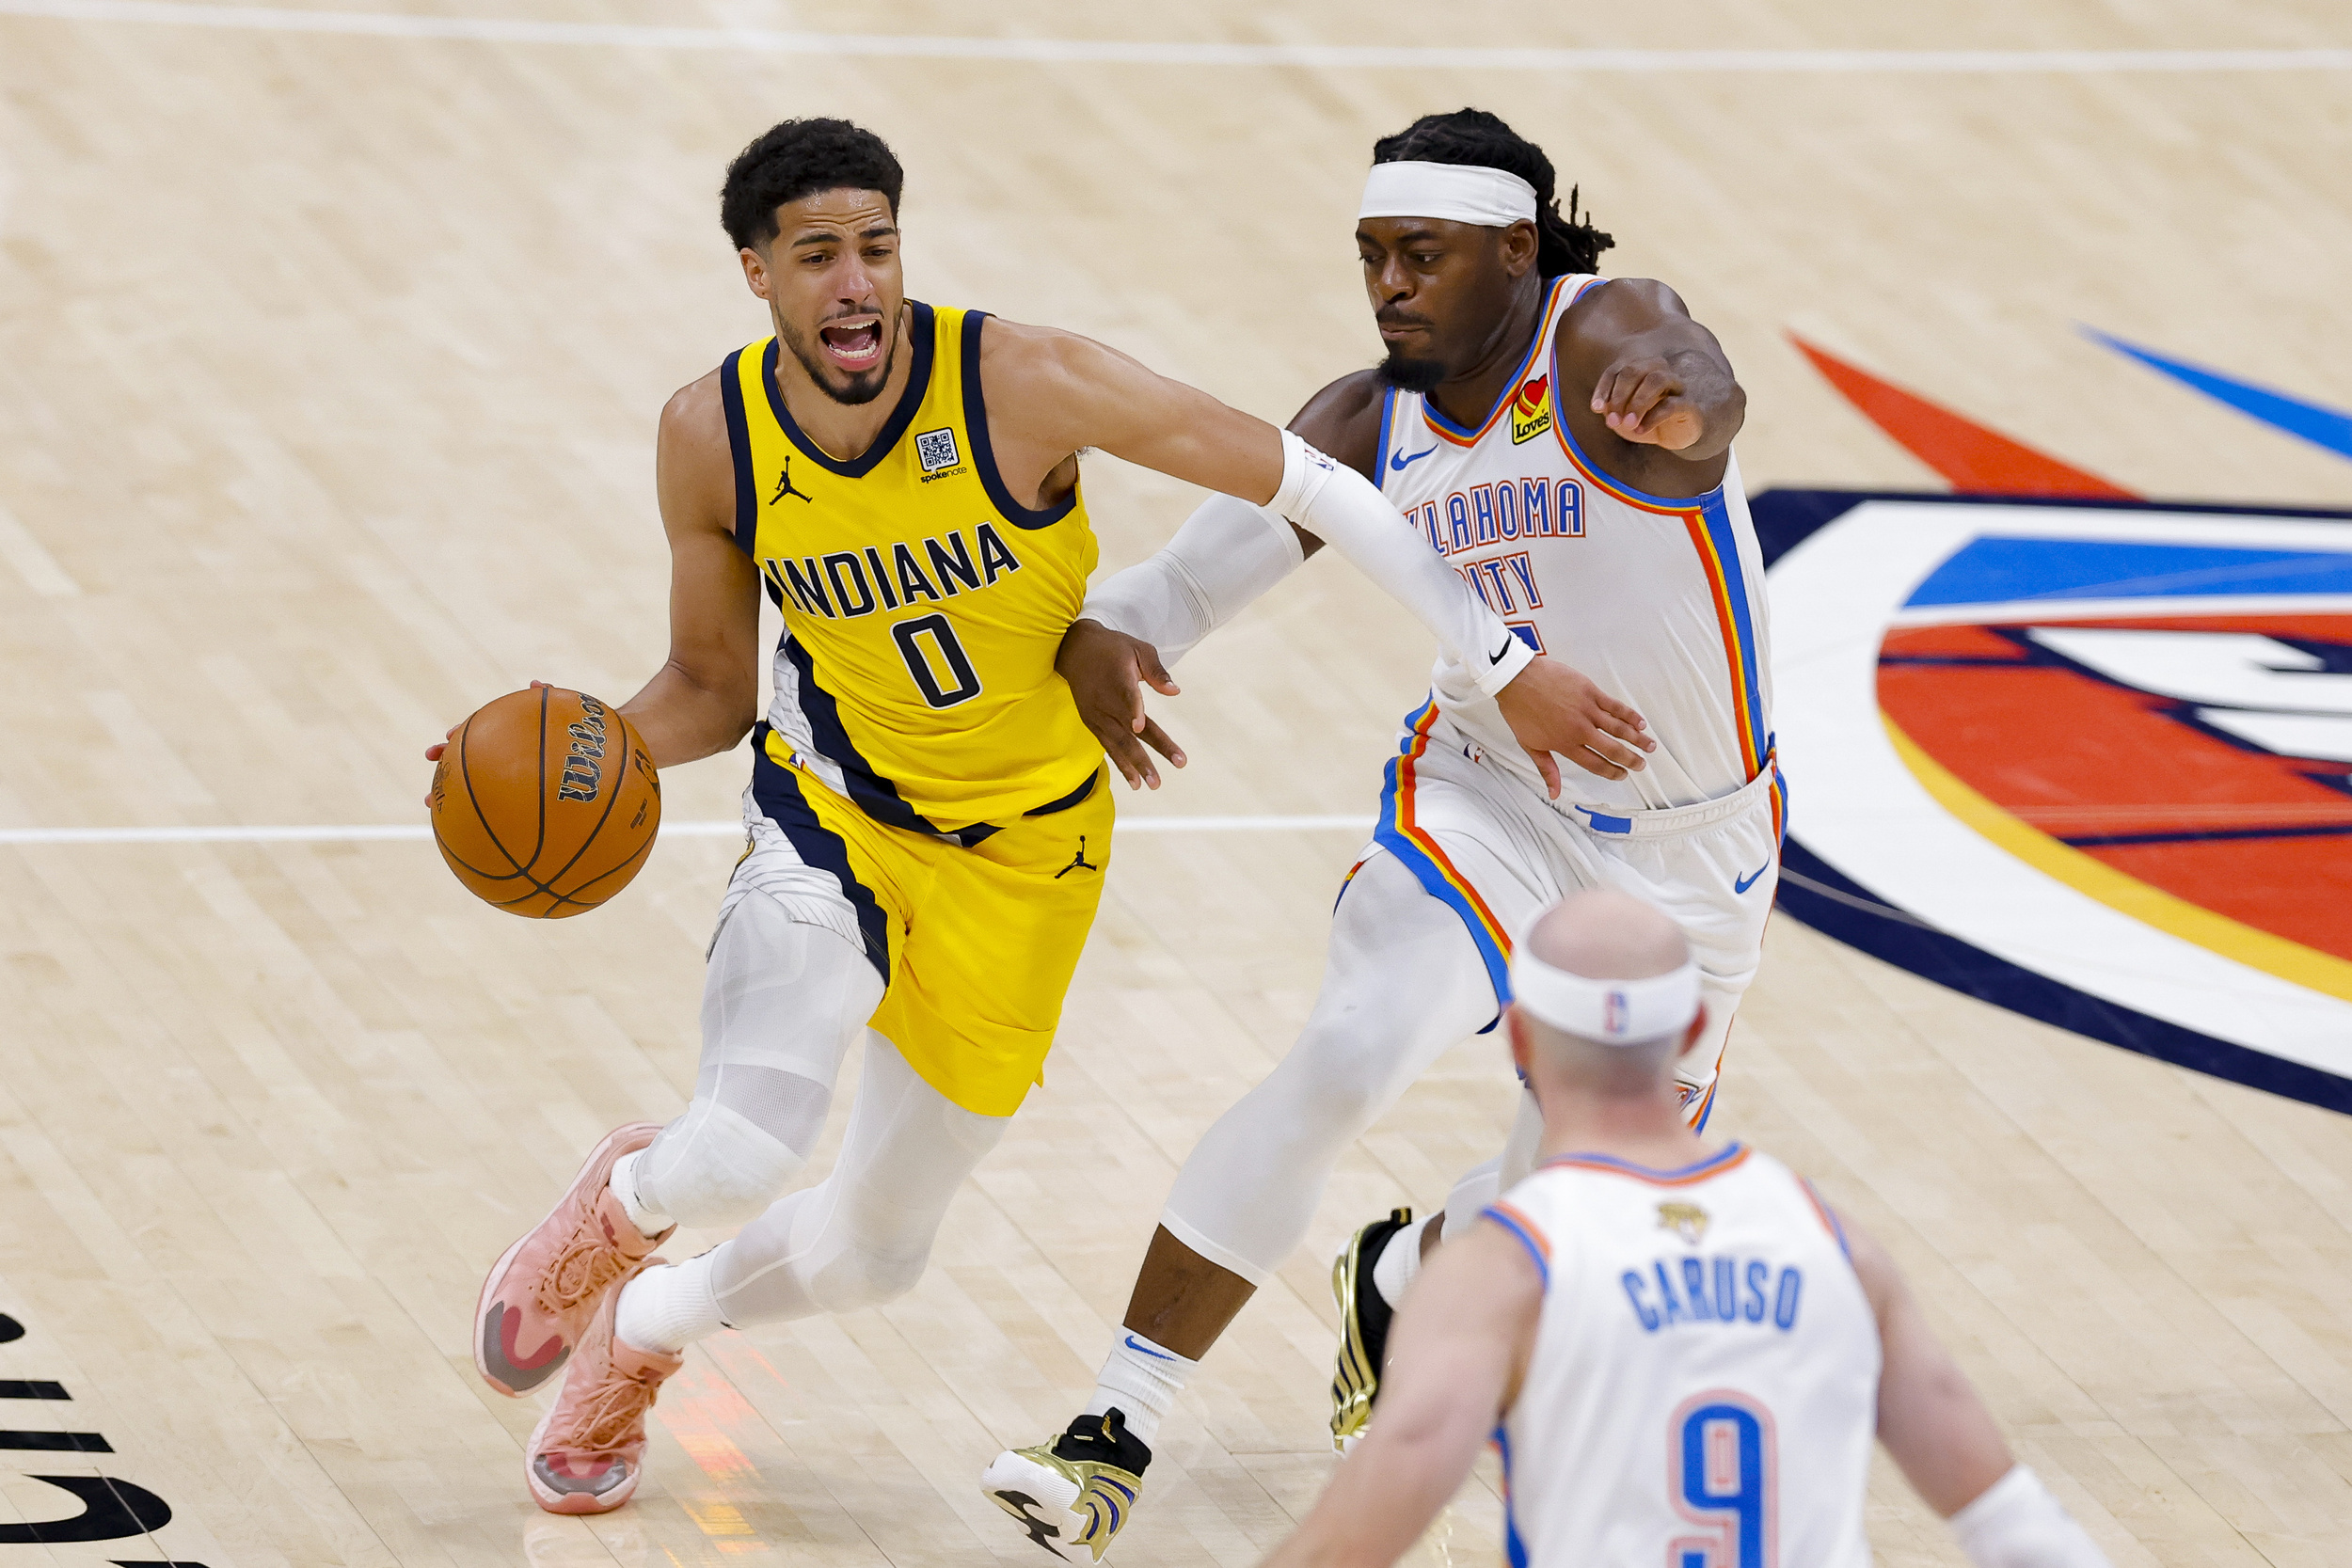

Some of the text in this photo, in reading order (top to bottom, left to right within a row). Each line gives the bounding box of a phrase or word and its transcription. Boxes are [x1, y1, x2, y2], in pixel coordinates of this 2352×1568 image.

[1516, 408, 1549, 438] Love's
[920, 467, 967, 483] spokenote
[1403, 477, 1586, 557] LAHOMA
[764, 521, 1021, 619] INDIANA
[1454, 551, 1543, 615] ITY
[889, 613, 983, 710] 0
[1619, 1256, 1803, 1333] CARUSO
[1666, 1386, 1780, 1568] 9
